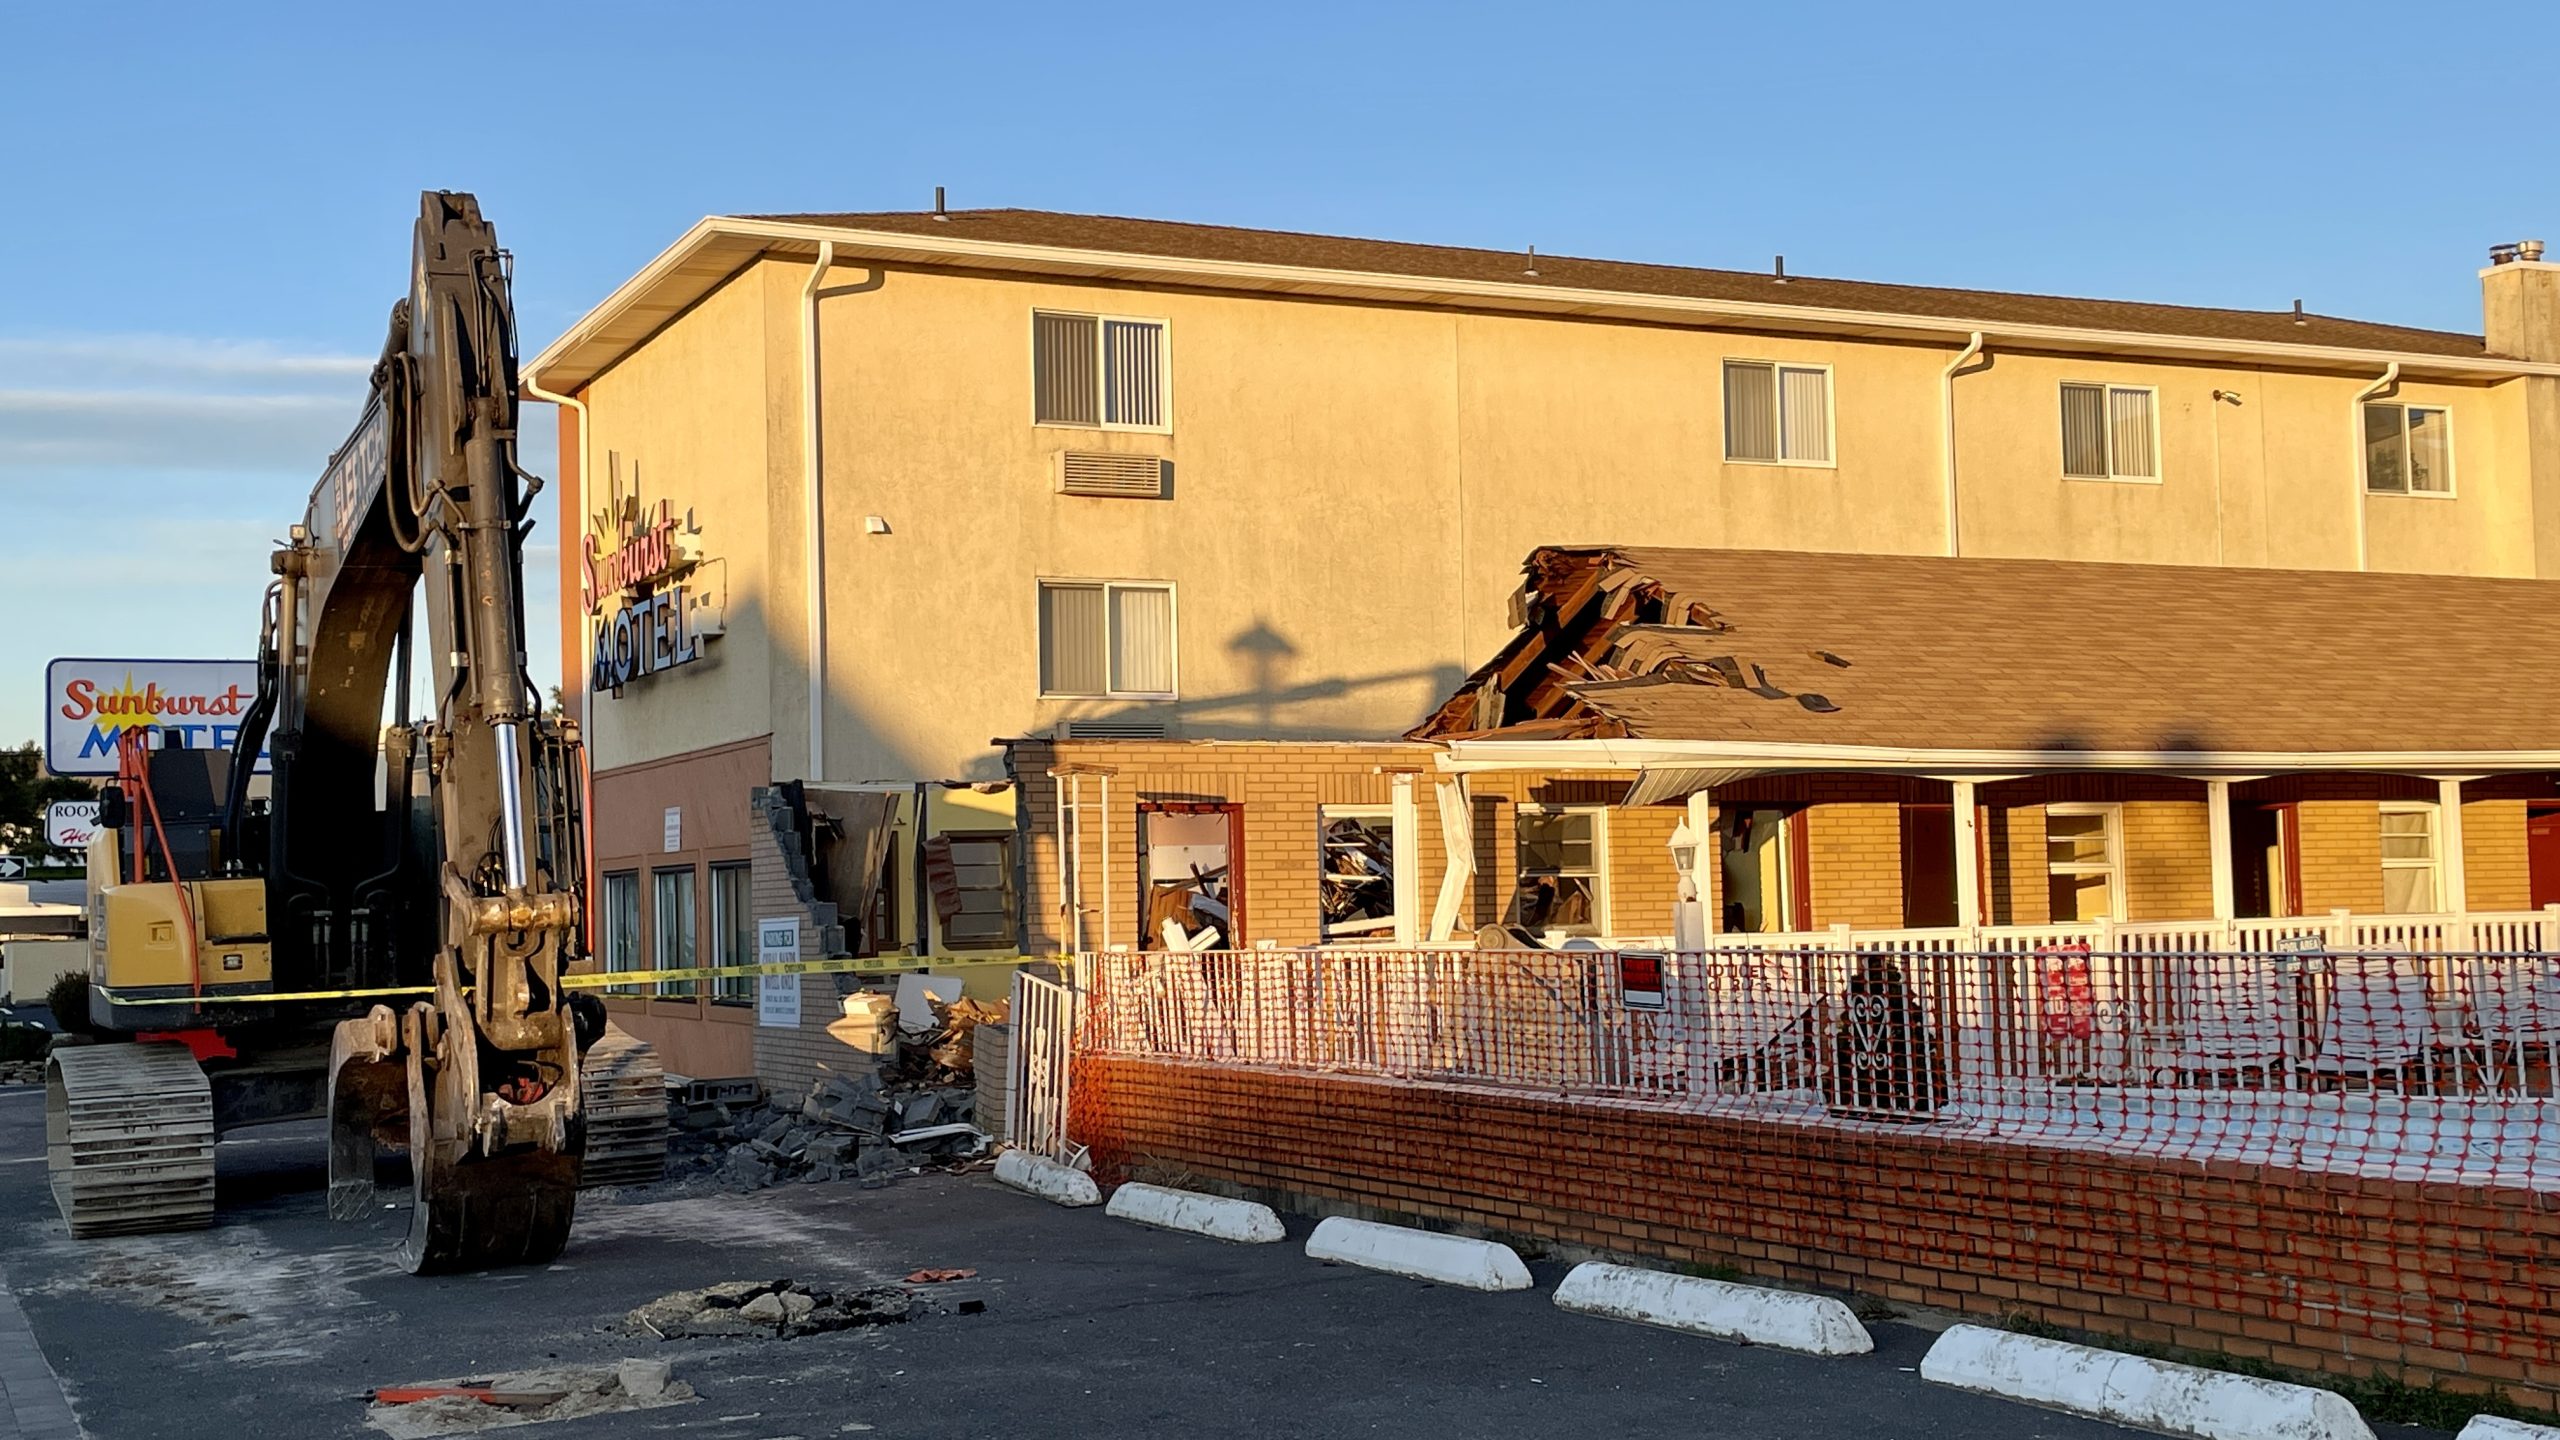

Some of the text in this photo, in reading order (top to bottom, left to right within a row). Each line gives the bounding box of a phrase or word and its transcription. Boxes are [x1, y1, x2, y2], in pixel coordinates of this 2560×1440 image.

[582, 498, 675, 616] Sunburst
[592, 585, 695, 692] MOTEL
[62, 679, 254, 720] Sunburst
[78, 724, 271, 759] MTE
